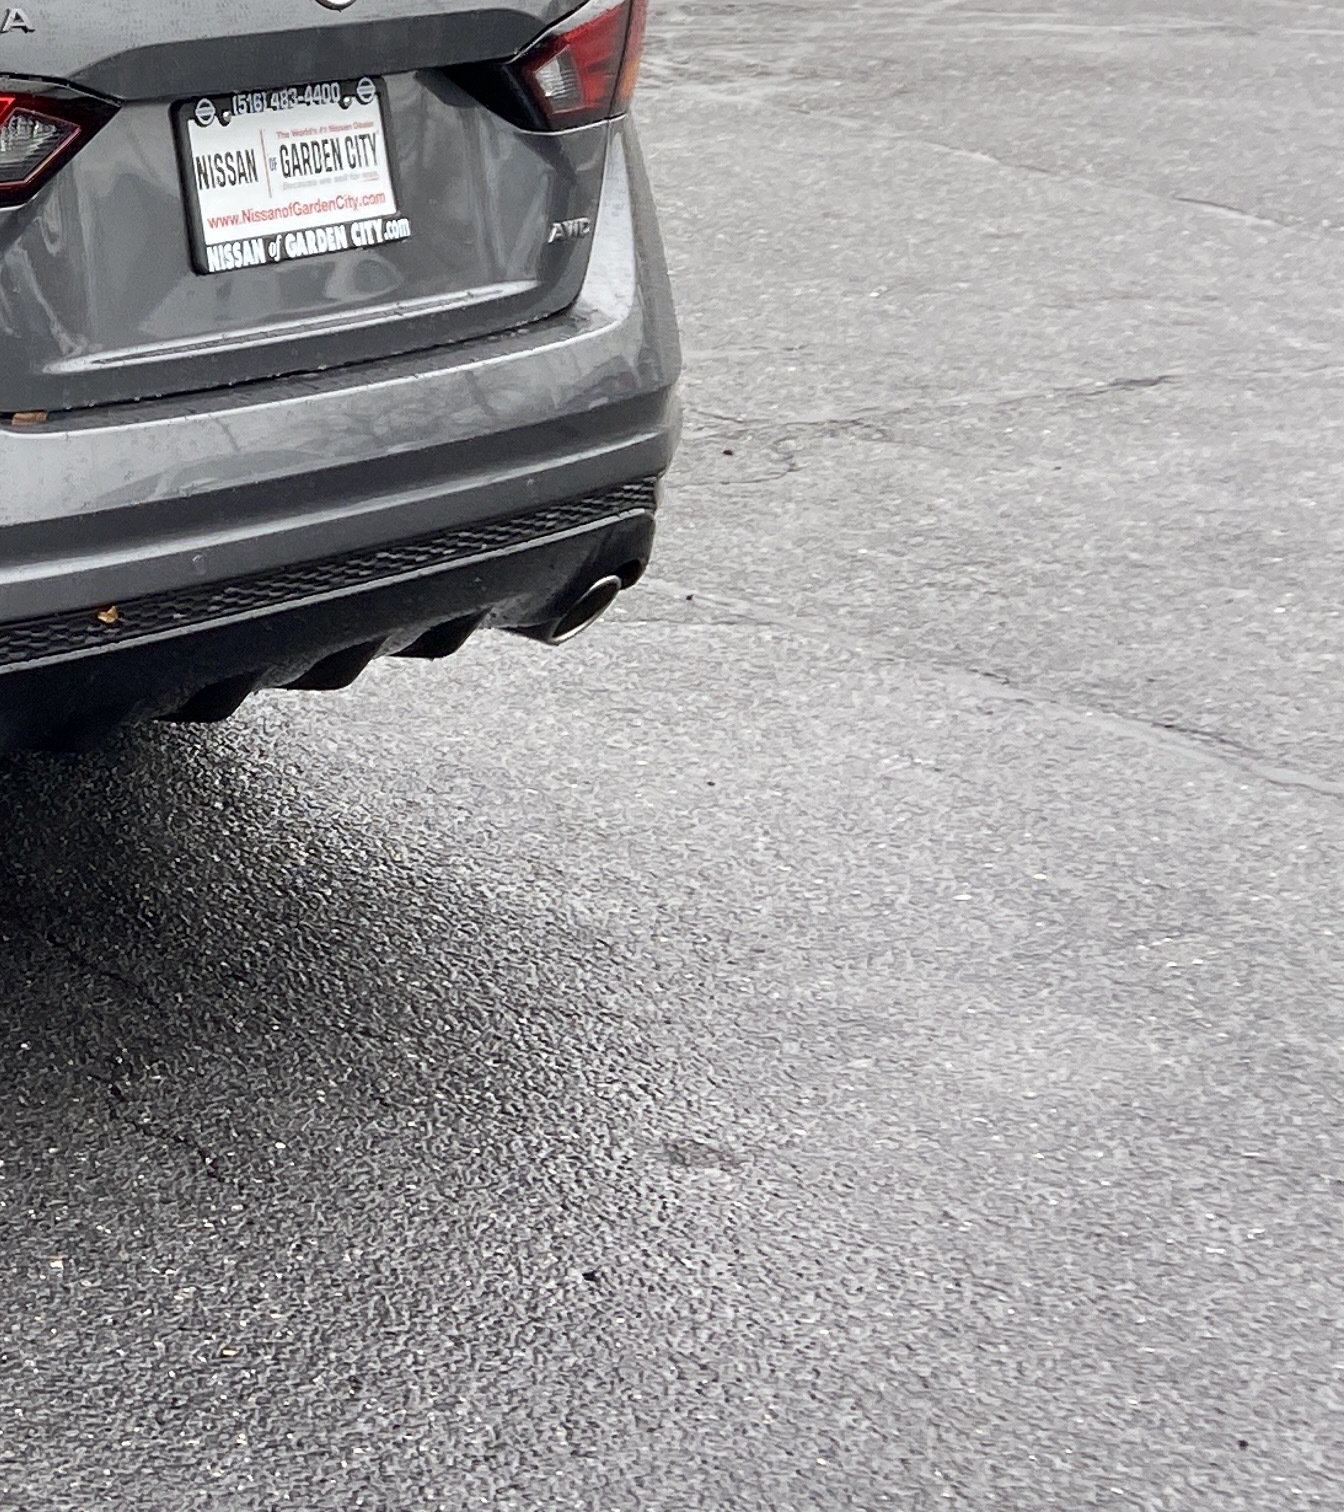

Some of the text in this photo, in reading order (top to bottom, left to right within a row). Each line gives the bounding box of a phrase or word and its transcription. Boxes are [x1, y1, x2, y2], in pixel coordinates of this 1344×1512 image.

[232, 82, 341, 116] (516) 483-4400
[196, 148, 258, 190] NISSAN
[279, 137, 344, 179] GARDEN
[344, 132, 378, 170] CITY
[207, 191, 387, 229] www.NissanofGardenCity.com
[206, 237, 267, 273] NISSAN
[268, 234, 283, 262] of
[284, 224, 348, 258] GARDEN
